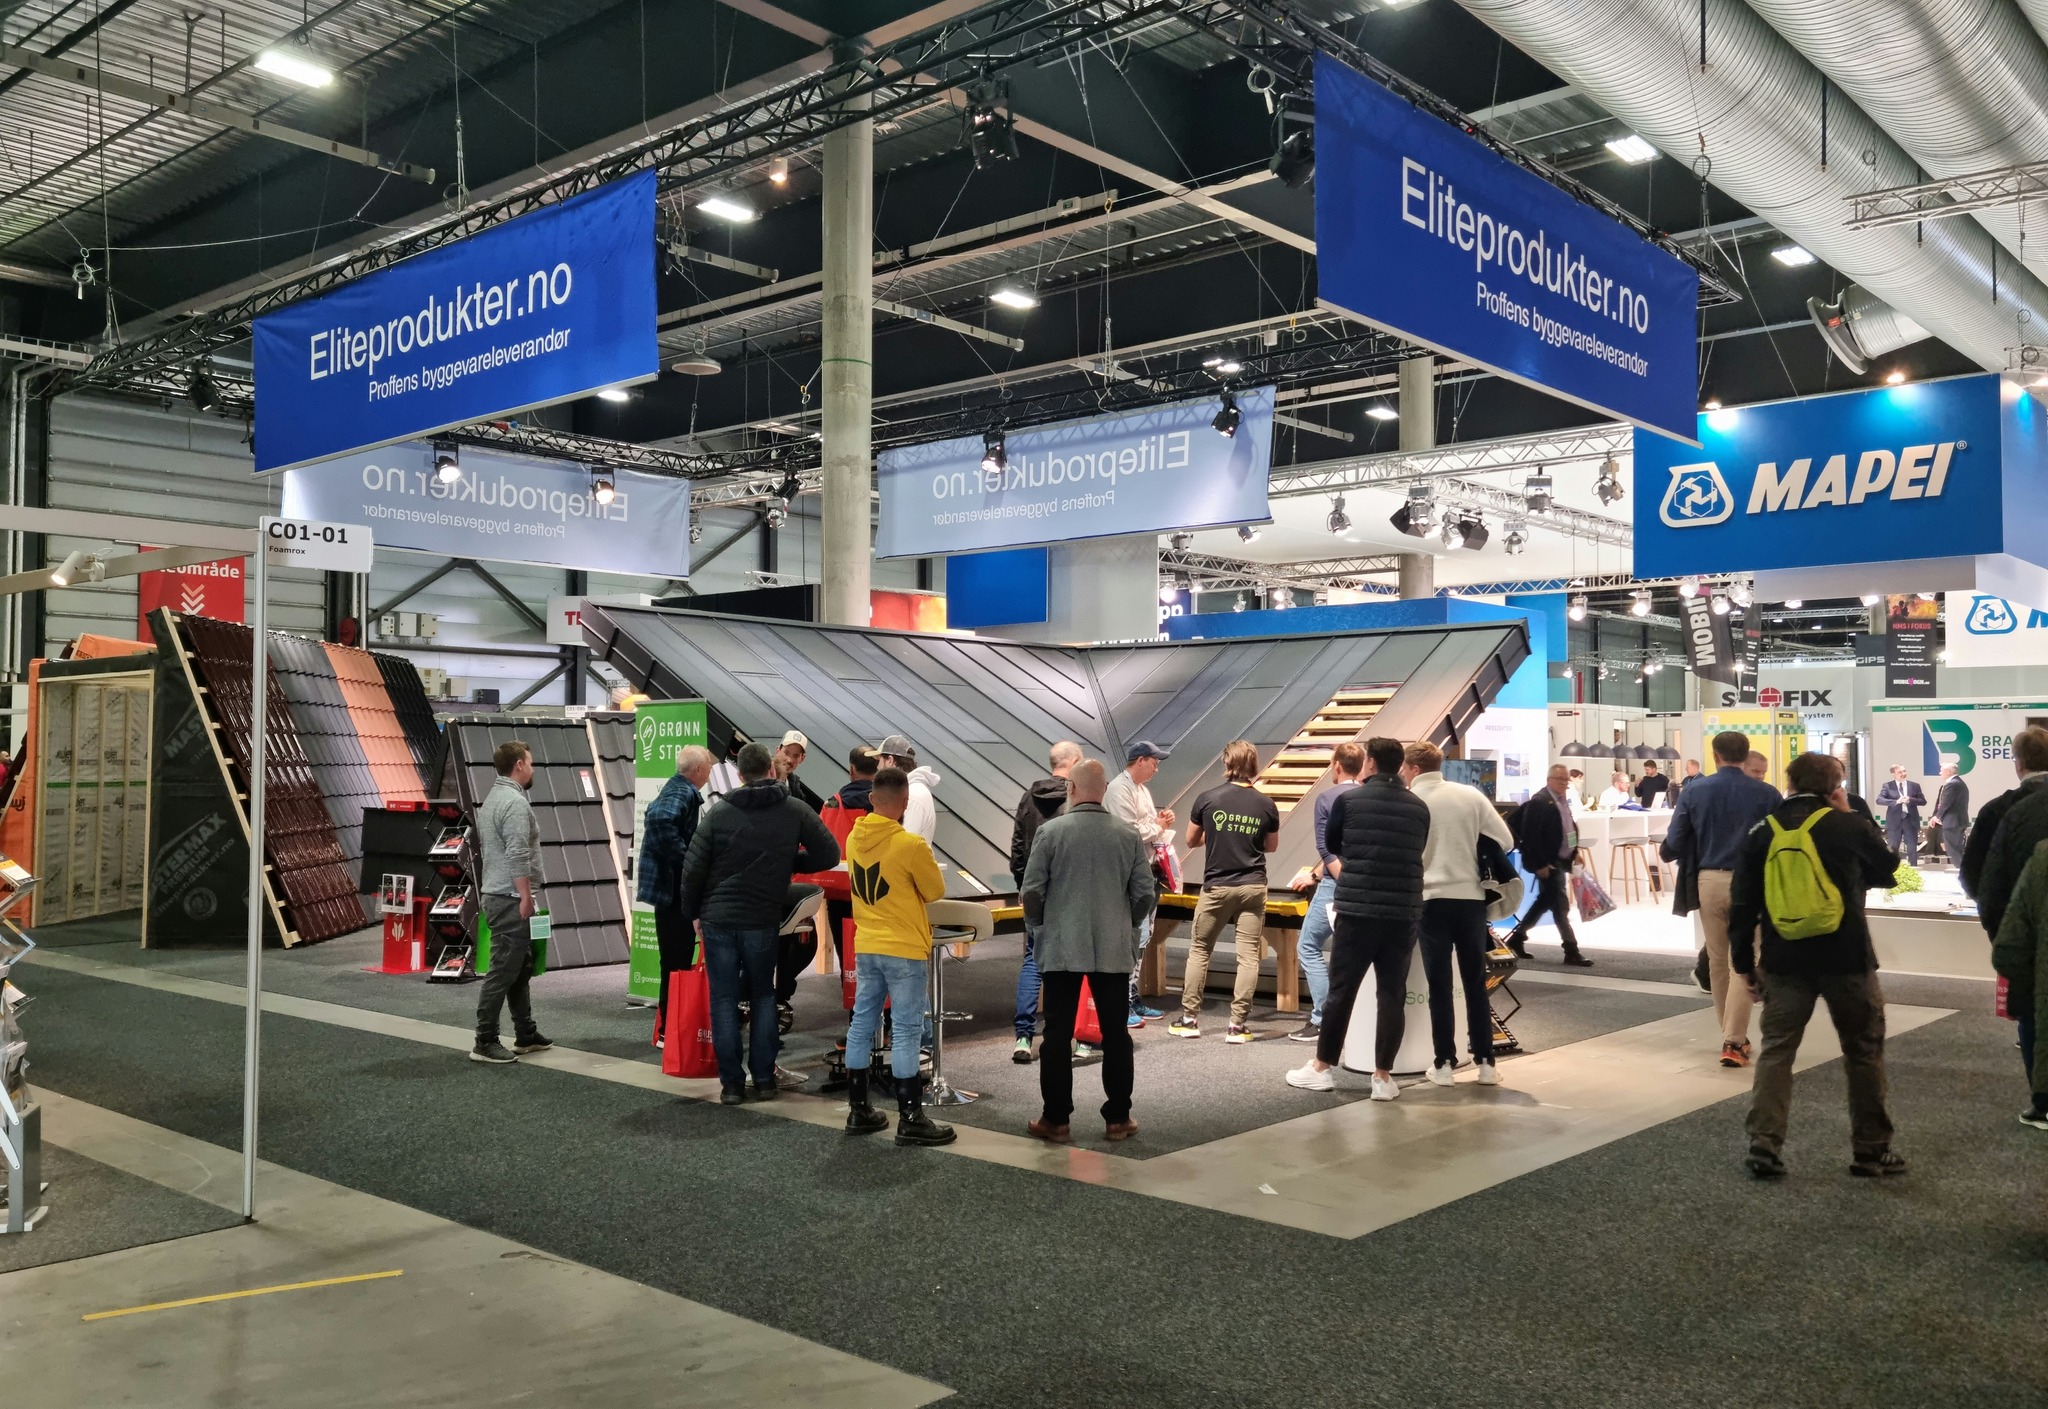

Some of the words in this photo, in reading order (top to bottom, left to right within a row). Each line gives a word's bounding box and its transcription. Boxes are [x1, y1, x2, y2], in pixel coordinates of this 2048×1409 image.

[1402, 156, 1649, 335] Eliteprodukter.no
[310, 262, 572, 381] Eliteprodukter.no
[1477, 281, 1530, 329] Proffens
[1532, 306, 1649, 378] byggevareleverandør
[368, 375, 419, 402] Proffens
[421, 326, 571, 391] byggevareleverandør
[268, 522, 348, 544] C01-01
[269, 545, 306, 555] Foamrox
[659, 721, 700, 737] GRØNN
[1227, 824, 1259, 835] STRØM
[1228, 813, 1262, 826] GRØNN
